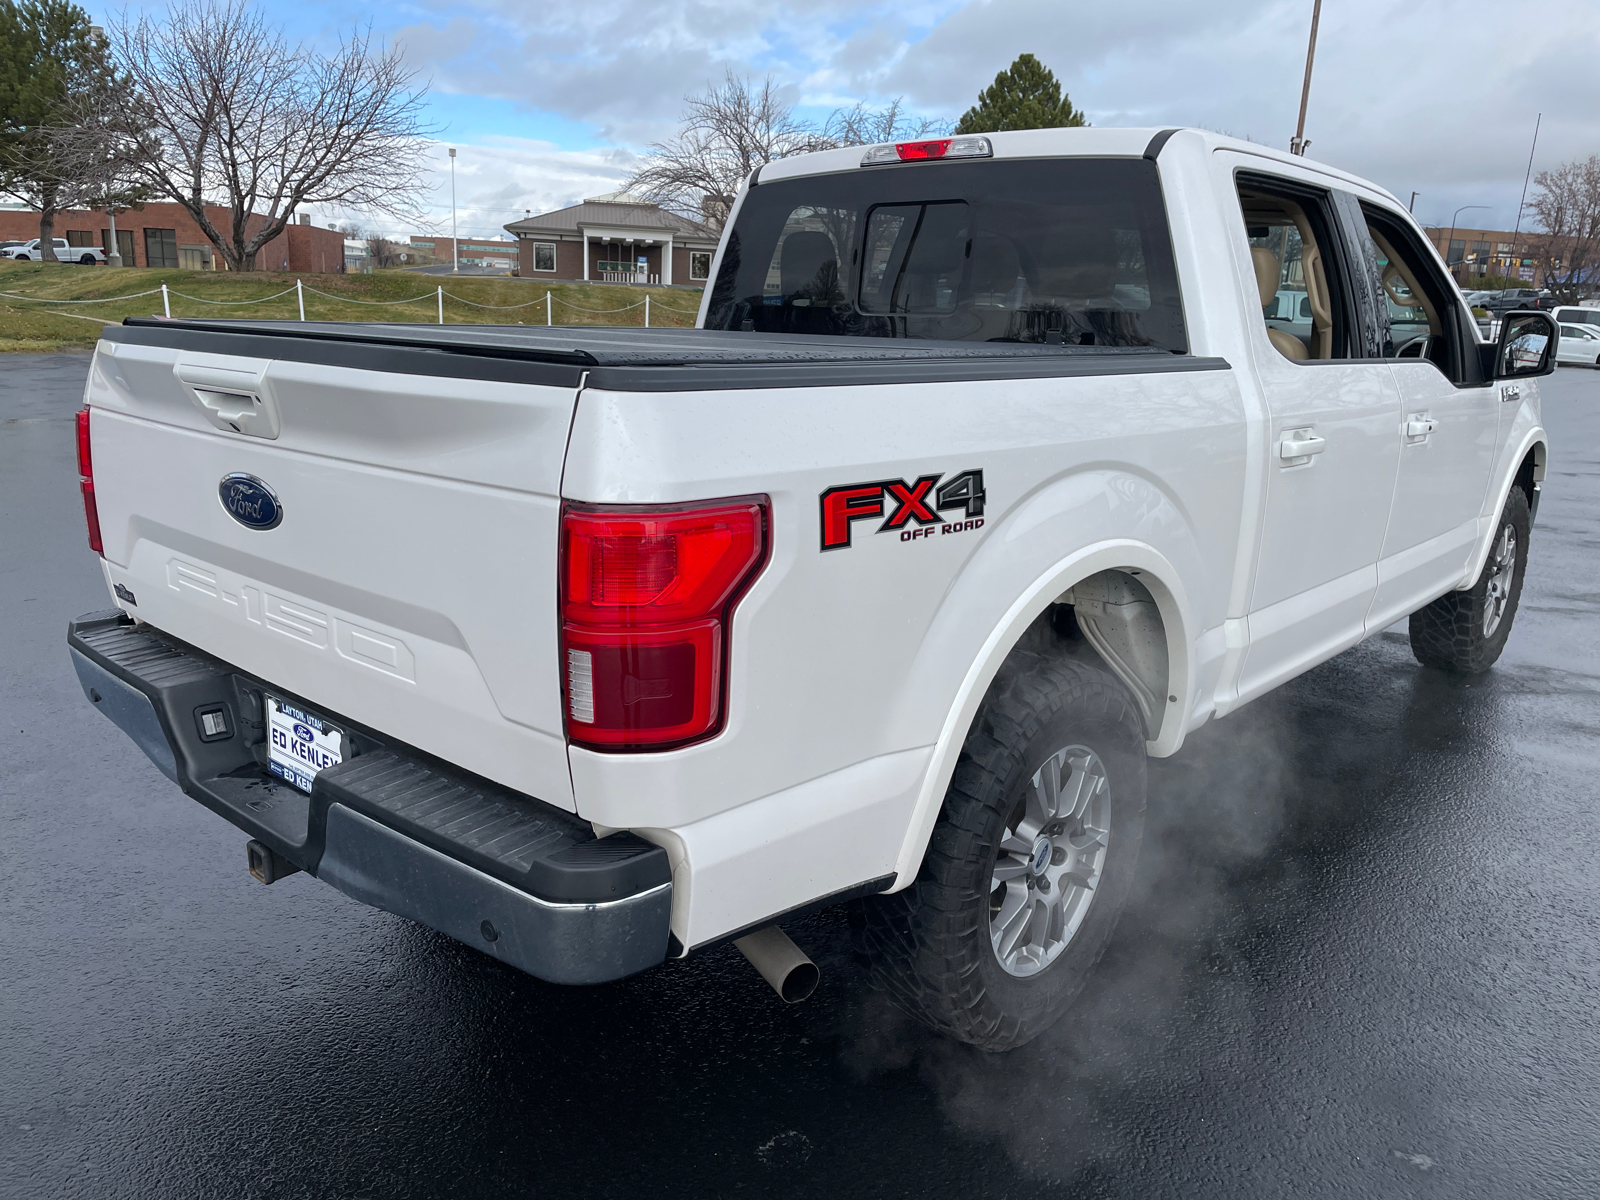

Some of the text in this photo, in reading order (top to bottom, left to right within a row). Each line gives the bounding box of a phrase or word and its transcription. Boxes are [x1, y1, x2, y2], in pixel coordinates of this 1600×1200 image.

[229, 484, 263, 519] Ford
[818, 468, 986, 553] FX4
[900, 518, 985, 542] OFF ROAD
[166, 557, 416, 685] F-150
[296, 725, 310, 741] Ford
[307, 715, 322, 730] UTAH
[272, 728, 286, 749] ED
[284, 768, 295, 783] ED
